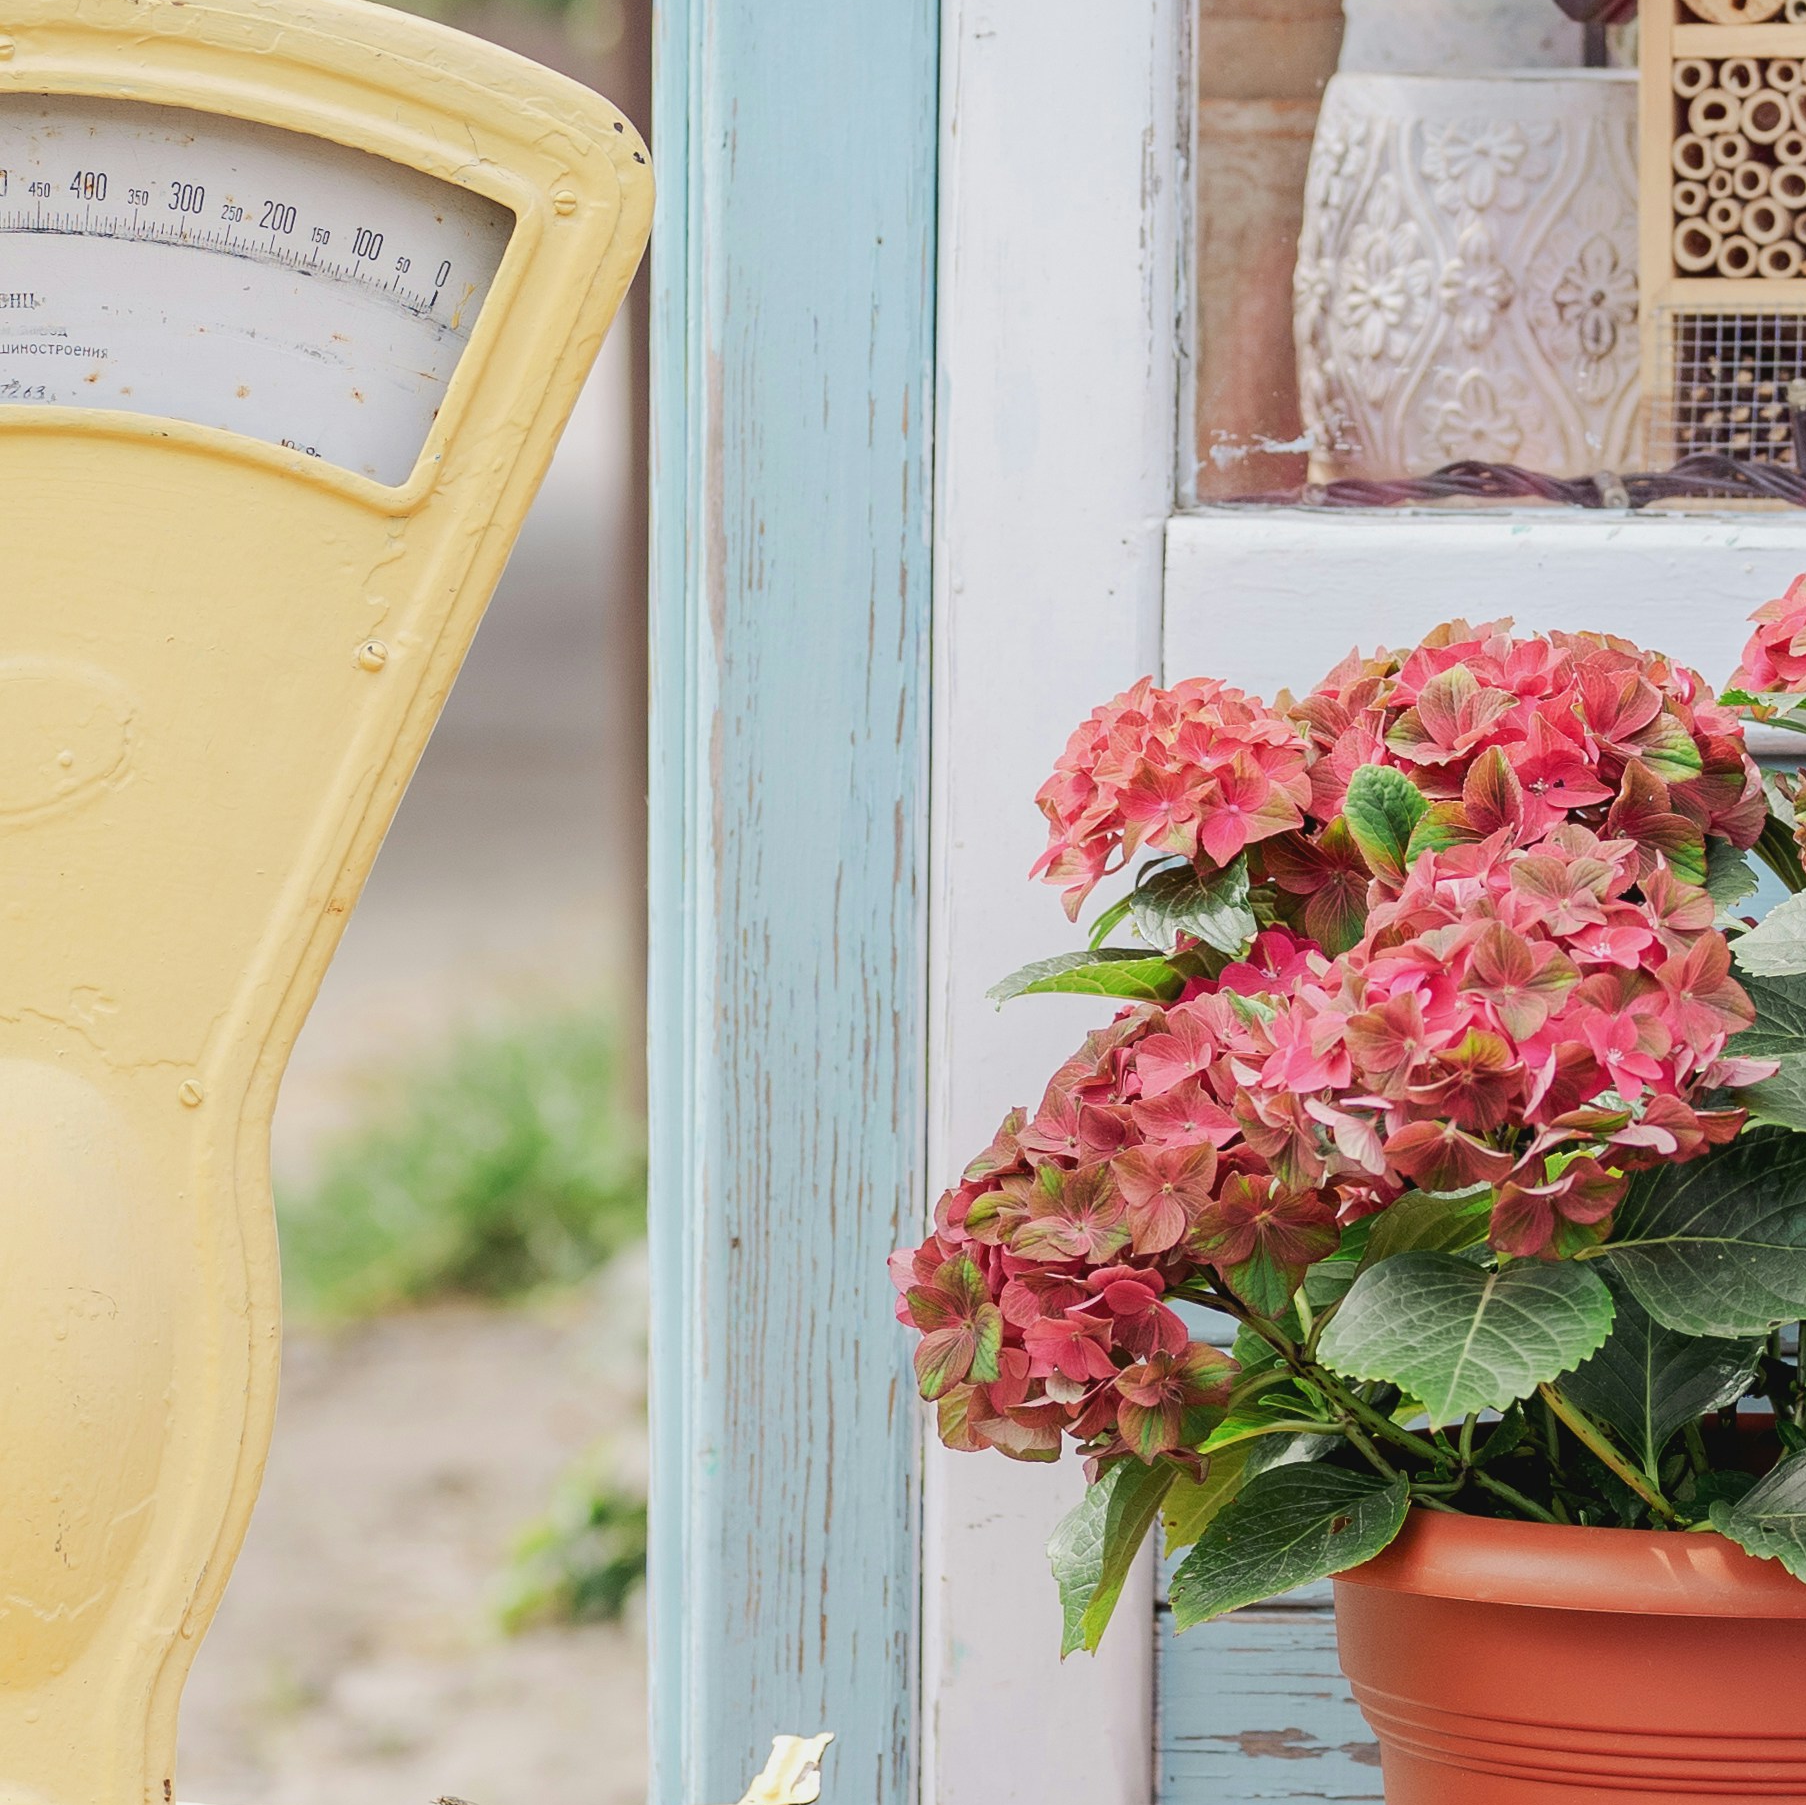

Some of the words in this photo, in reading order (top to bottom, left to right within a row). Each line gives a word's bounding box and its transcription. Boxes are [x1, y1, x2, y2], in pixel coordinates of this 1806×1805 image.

[28, 181, 51, 198] 450
[69, 170, 108, 201] 400
[127, 188, 149, 206] 350
[168, 181, 205, 214] 300
[221, 204, 243, 223] 250
[259, 200, 297, 234] 200
[311, 227, 331, 245] 150
[352, 227, 384, 261] 100
[395, 256, 411, 274] 50
[434, 260, 451, 288] 0
